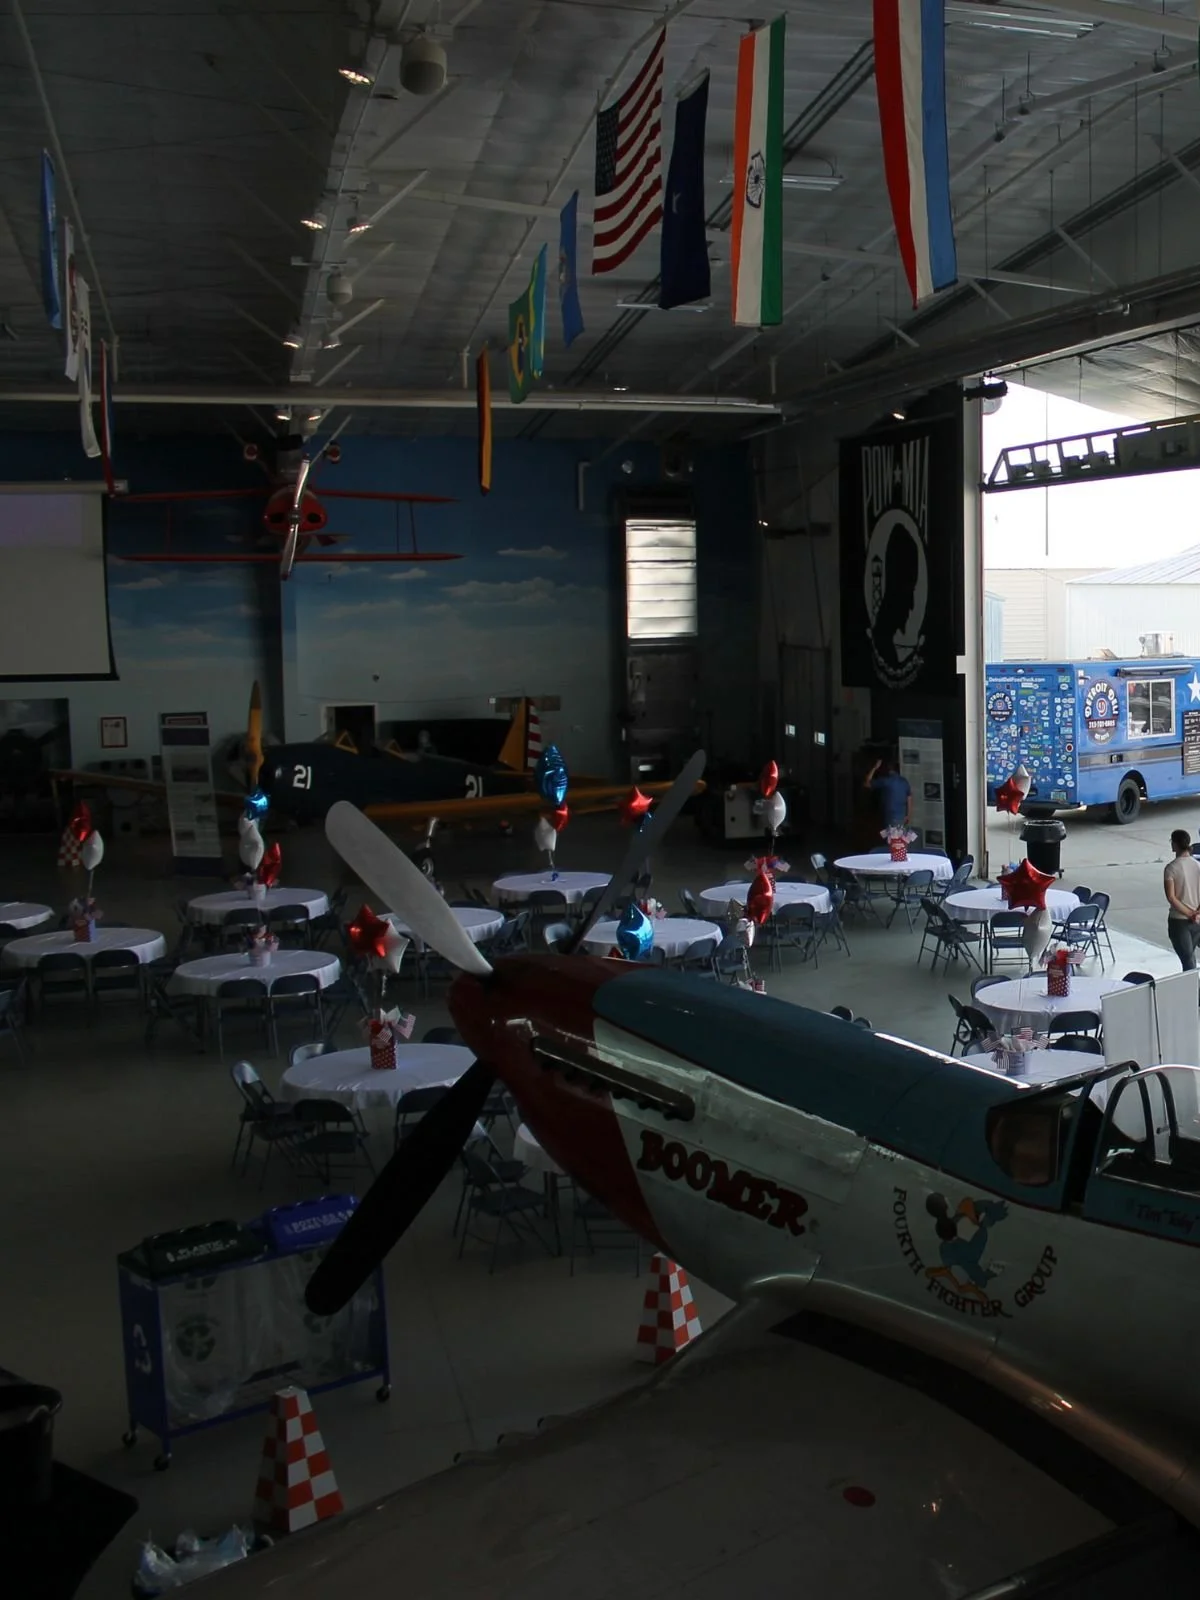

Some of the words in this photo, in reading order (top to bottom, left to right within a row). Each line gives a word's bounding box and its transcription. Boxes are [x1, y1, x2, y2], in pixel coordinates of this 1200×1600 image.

[861, 445, 895, 553] POW
[901, 436, 929, 545] MIA
[1085, 682, 1108, 718] DETROIT
[1107, 688, 1119, 714] DELI
[293, 764, 312, 790] 21
[464, 773, 483, 798] 21
[637, 1130, 808, 1236] BOOMER
[892, 1186, 925, 1276] FOURTH
[926, 1277, 1013, 1318] FIGHTER
[1014, 1245, 1059, 1308] GROUP
